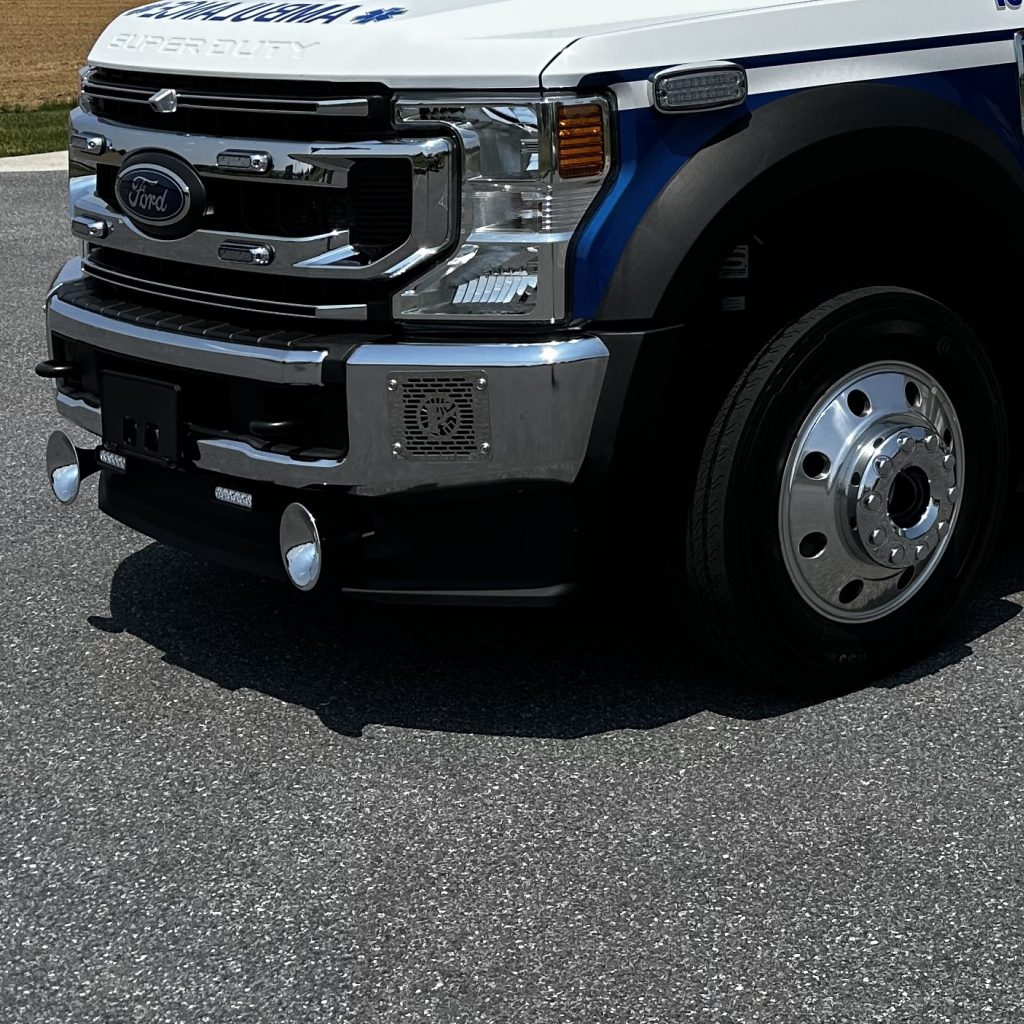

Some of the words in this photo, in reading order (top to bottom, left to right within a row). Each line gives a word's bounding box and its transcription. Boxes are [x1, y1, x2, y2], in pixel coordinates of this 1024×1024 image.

[108, 32, 205, 55] SUPER
[207, 38, 320, 59] DUTY
[128, 176, 169, 212] Ford
